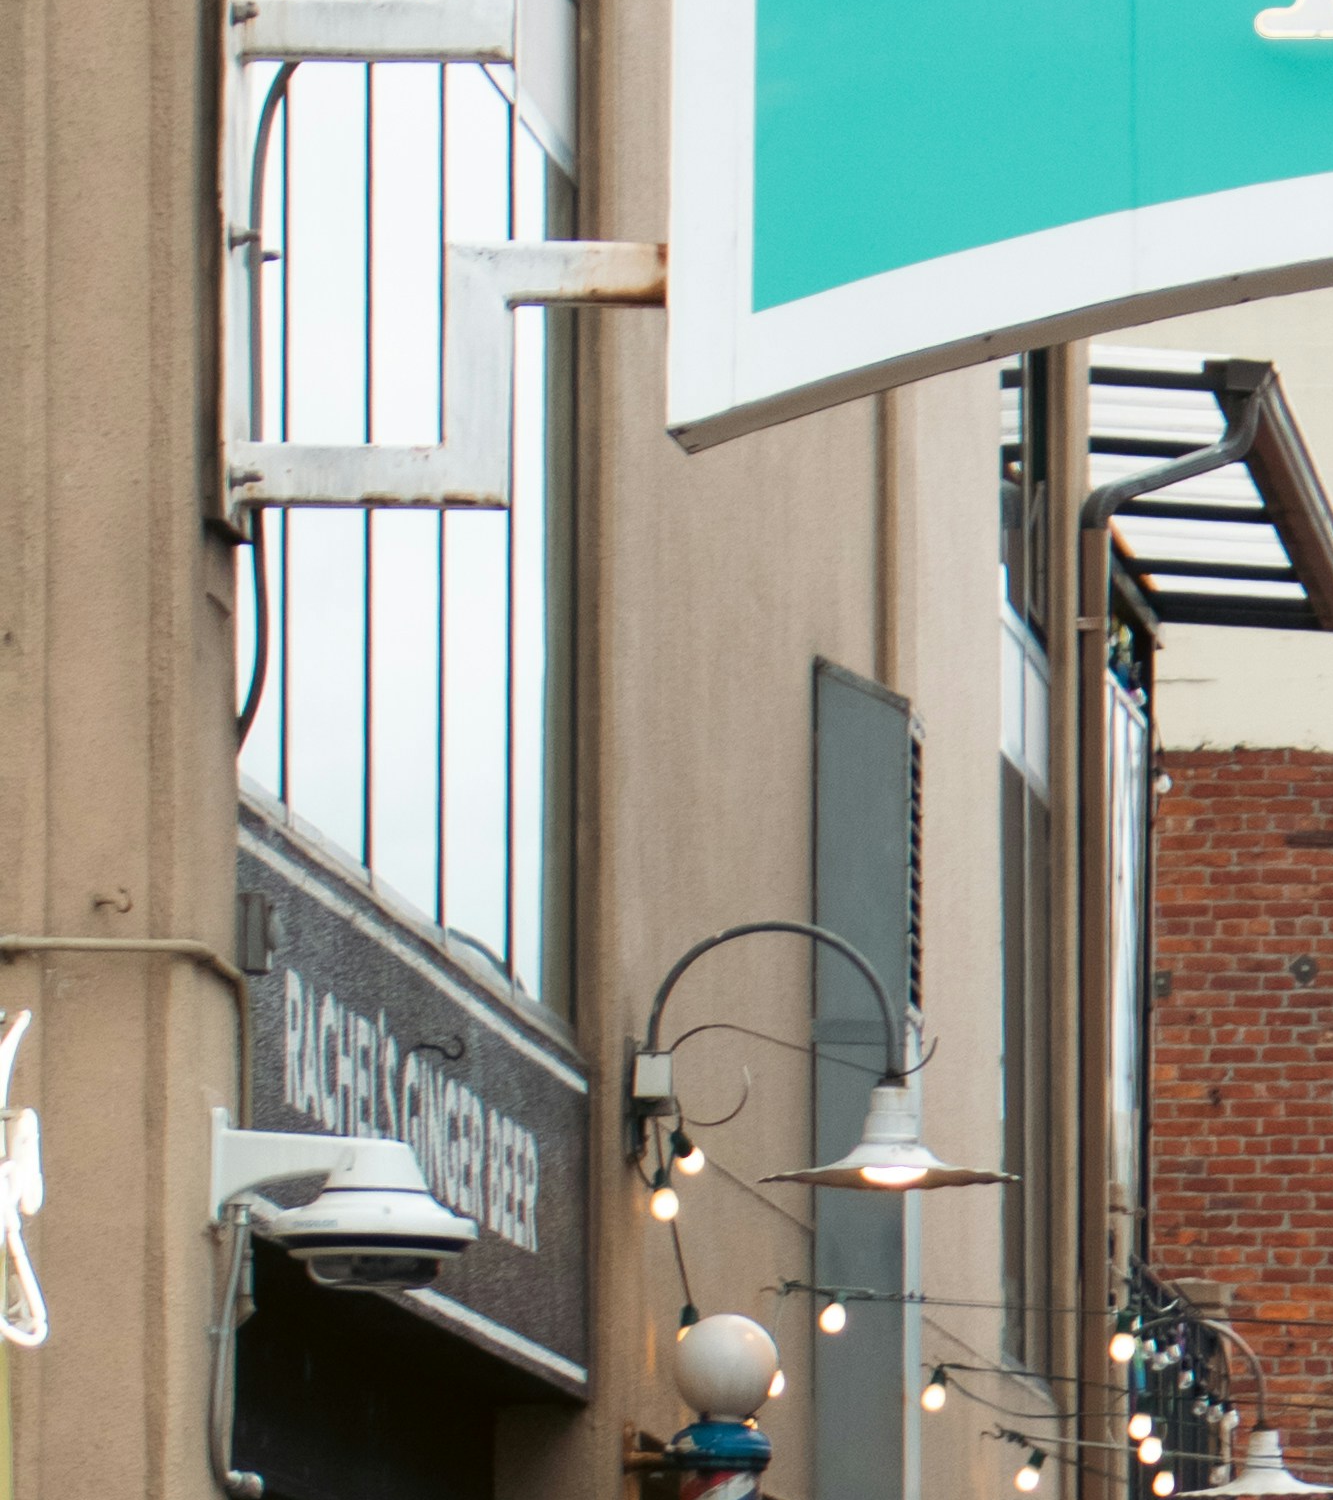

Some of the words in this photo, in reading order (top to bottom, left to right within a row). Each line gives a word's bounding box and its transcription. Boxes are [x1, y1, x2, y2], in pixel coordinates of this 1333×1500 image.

[284, 967, 399, 1140] RACHEL'S
[402, 1050, 485, 1225] GINGER
[487, 1107, 539, 1254] BEER
